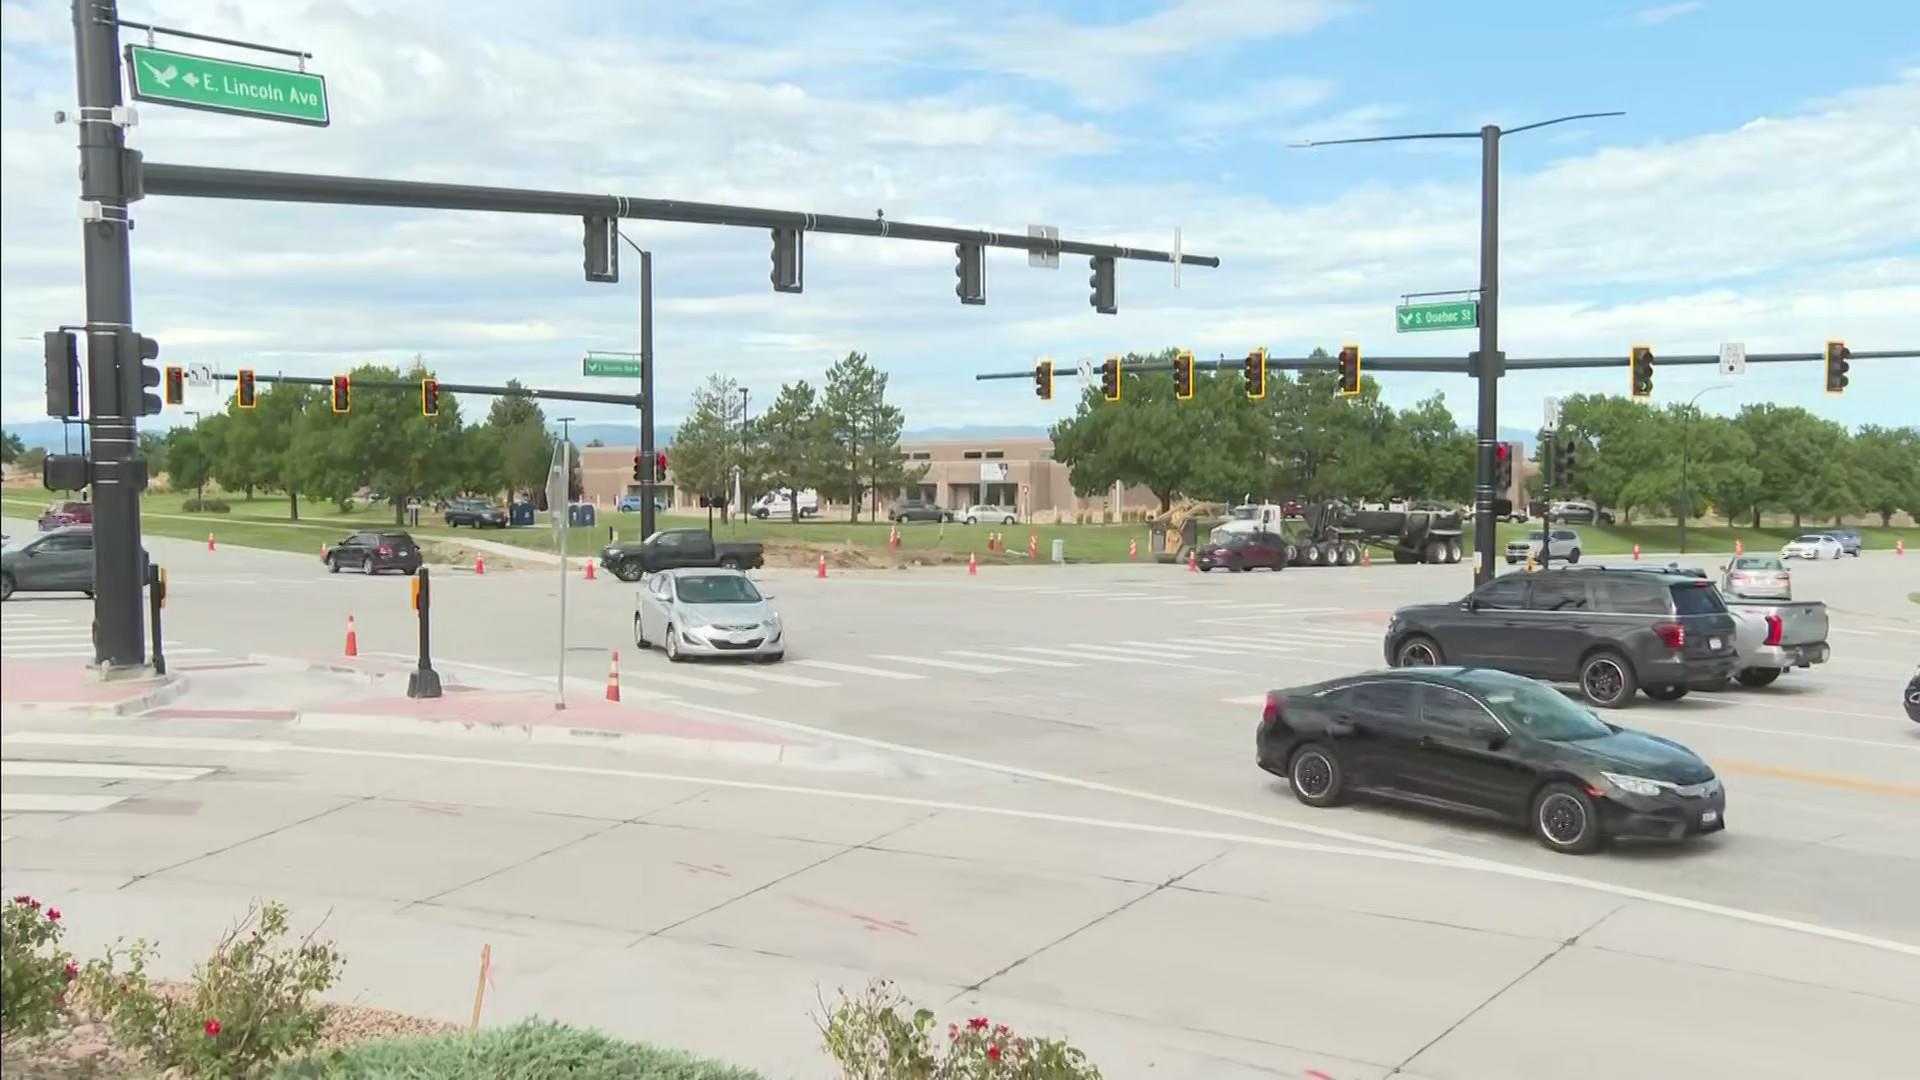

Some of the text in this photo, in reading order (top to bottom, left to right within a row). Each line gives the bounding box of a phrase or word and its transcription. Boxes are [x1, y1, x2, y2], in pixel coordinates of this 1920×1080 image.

[203, 73, 318, 106] E. Lincoln Ave
[1425, 311, 1458, 323] Quebec
[1461, 308, 1471, 321] St
